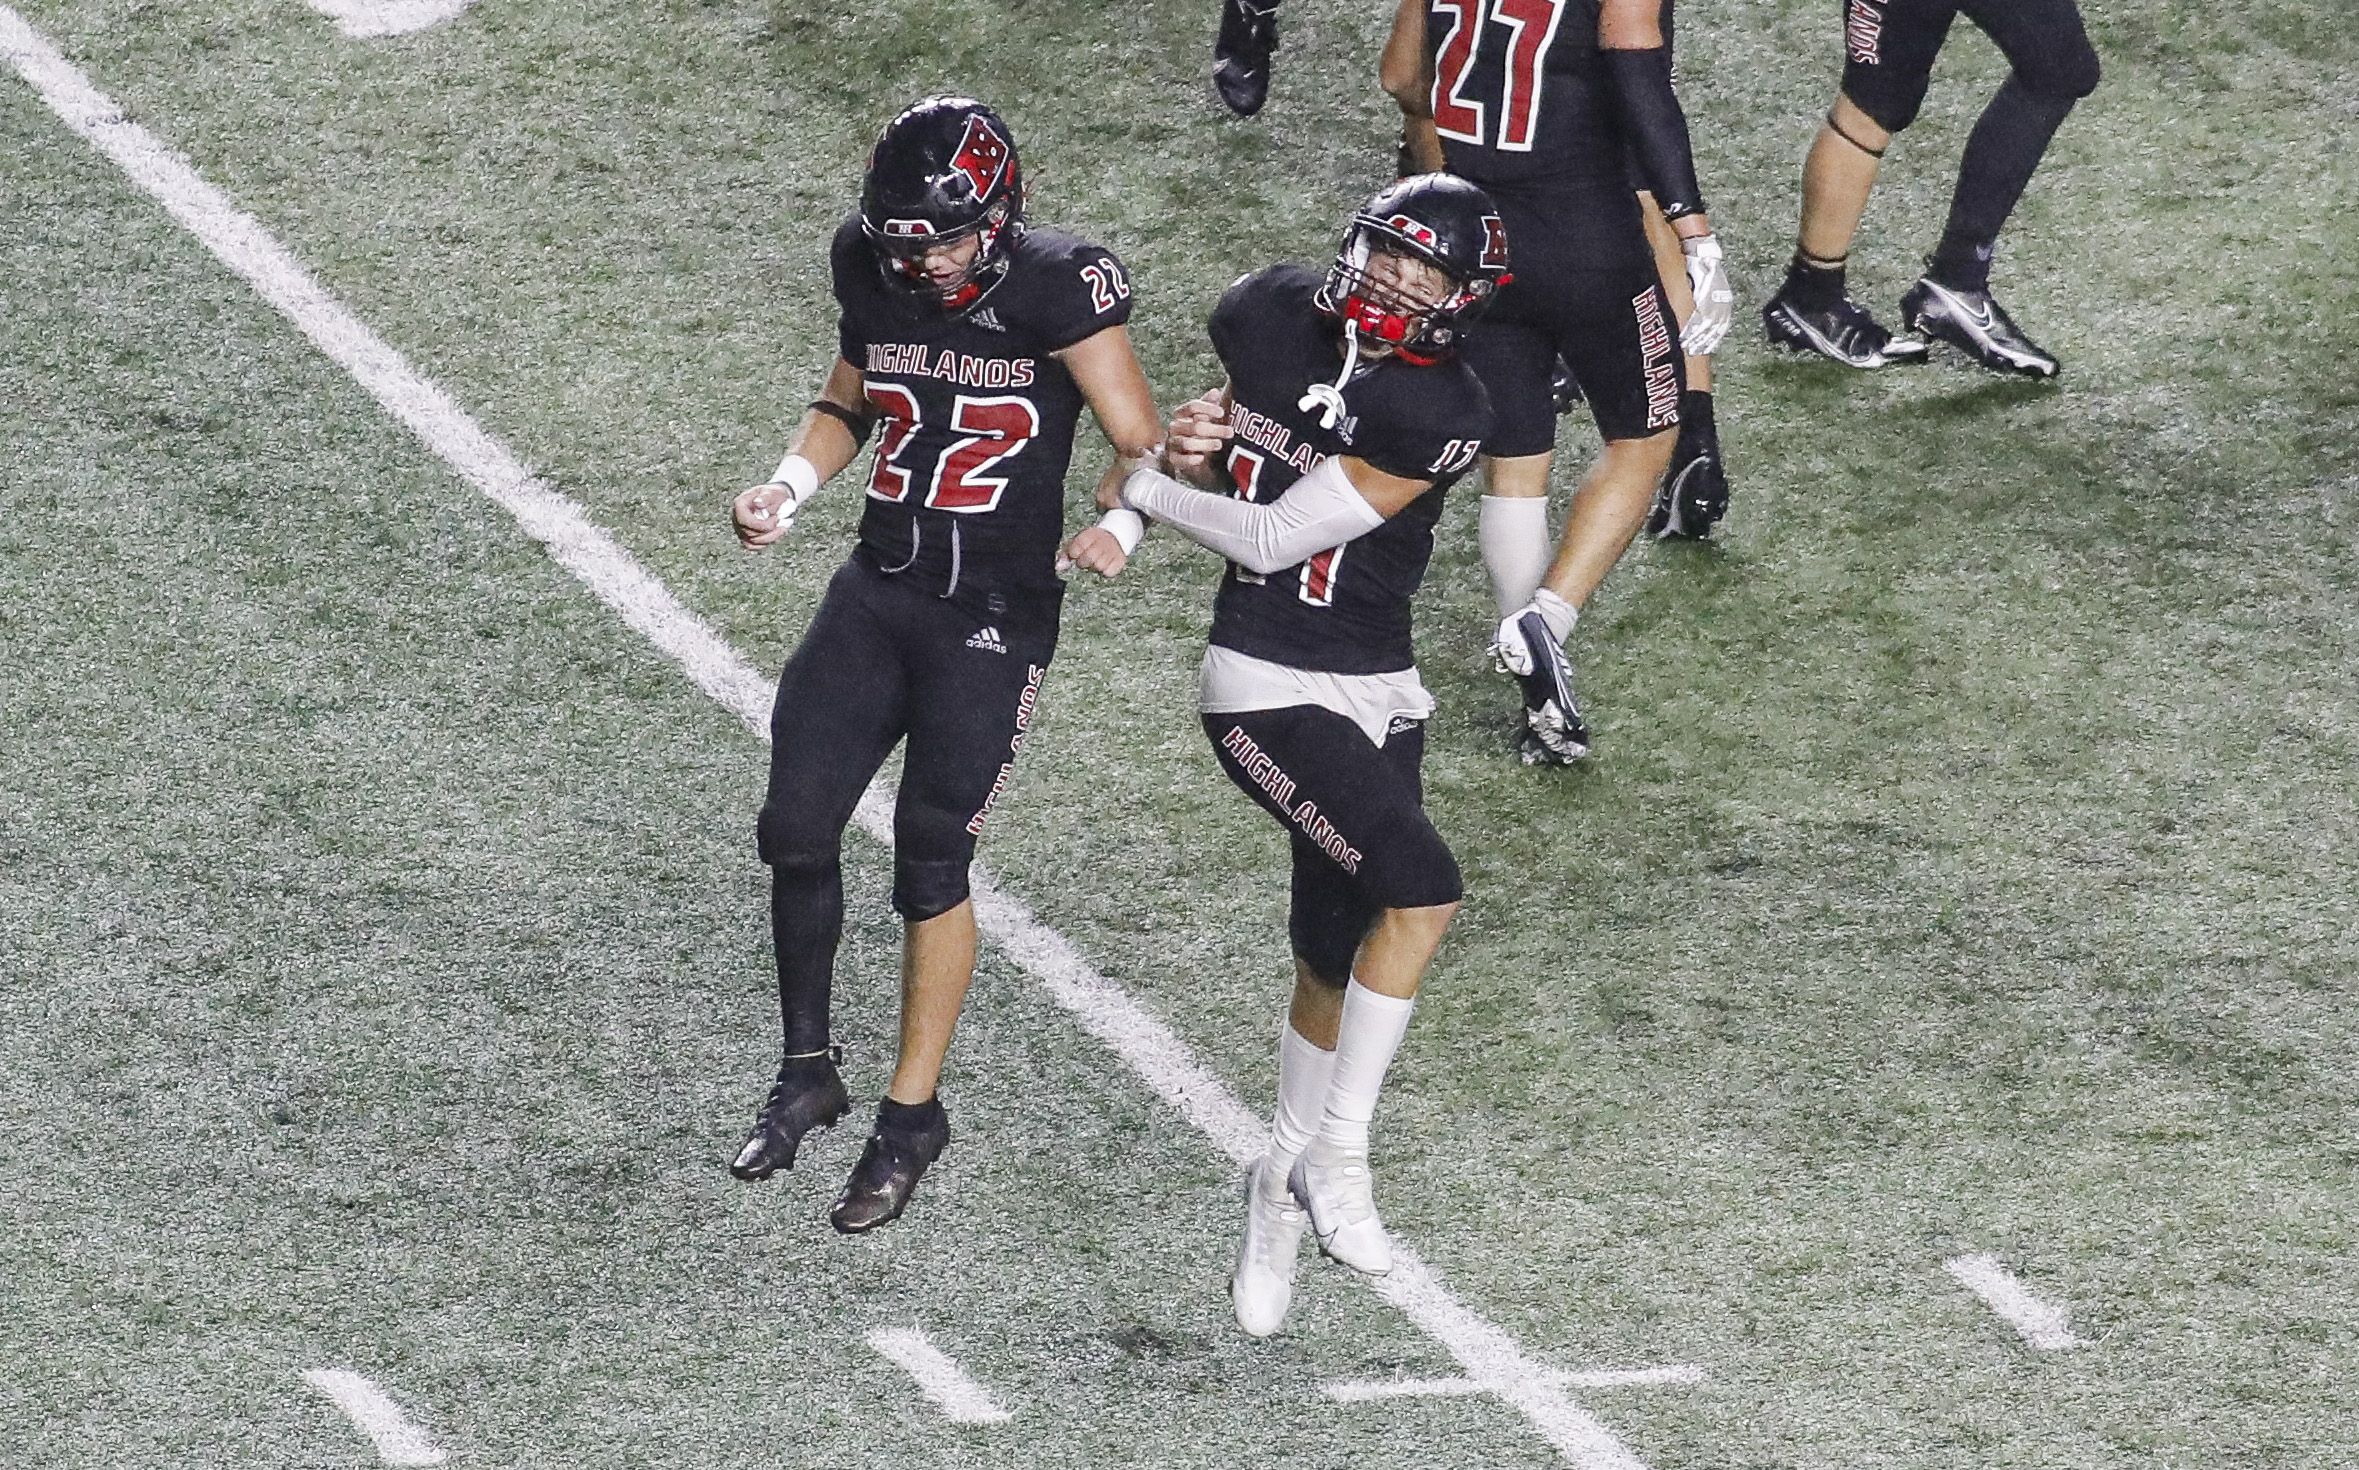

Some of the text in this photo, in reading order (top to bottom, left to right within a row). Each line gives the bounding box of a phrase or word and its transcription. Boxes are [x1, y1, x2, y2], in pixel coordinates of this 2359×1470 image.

[1430, 0, 1566, 152] 27
[1079, 257, 1130, 314] 22
[1631, 284, 1680, 429] HIGHLANDS
[863, 379, 1040, 514] 22
[965, 638, 1007, 654] adidas
[1221, 725, 1363, 876] HIGHLANDS
